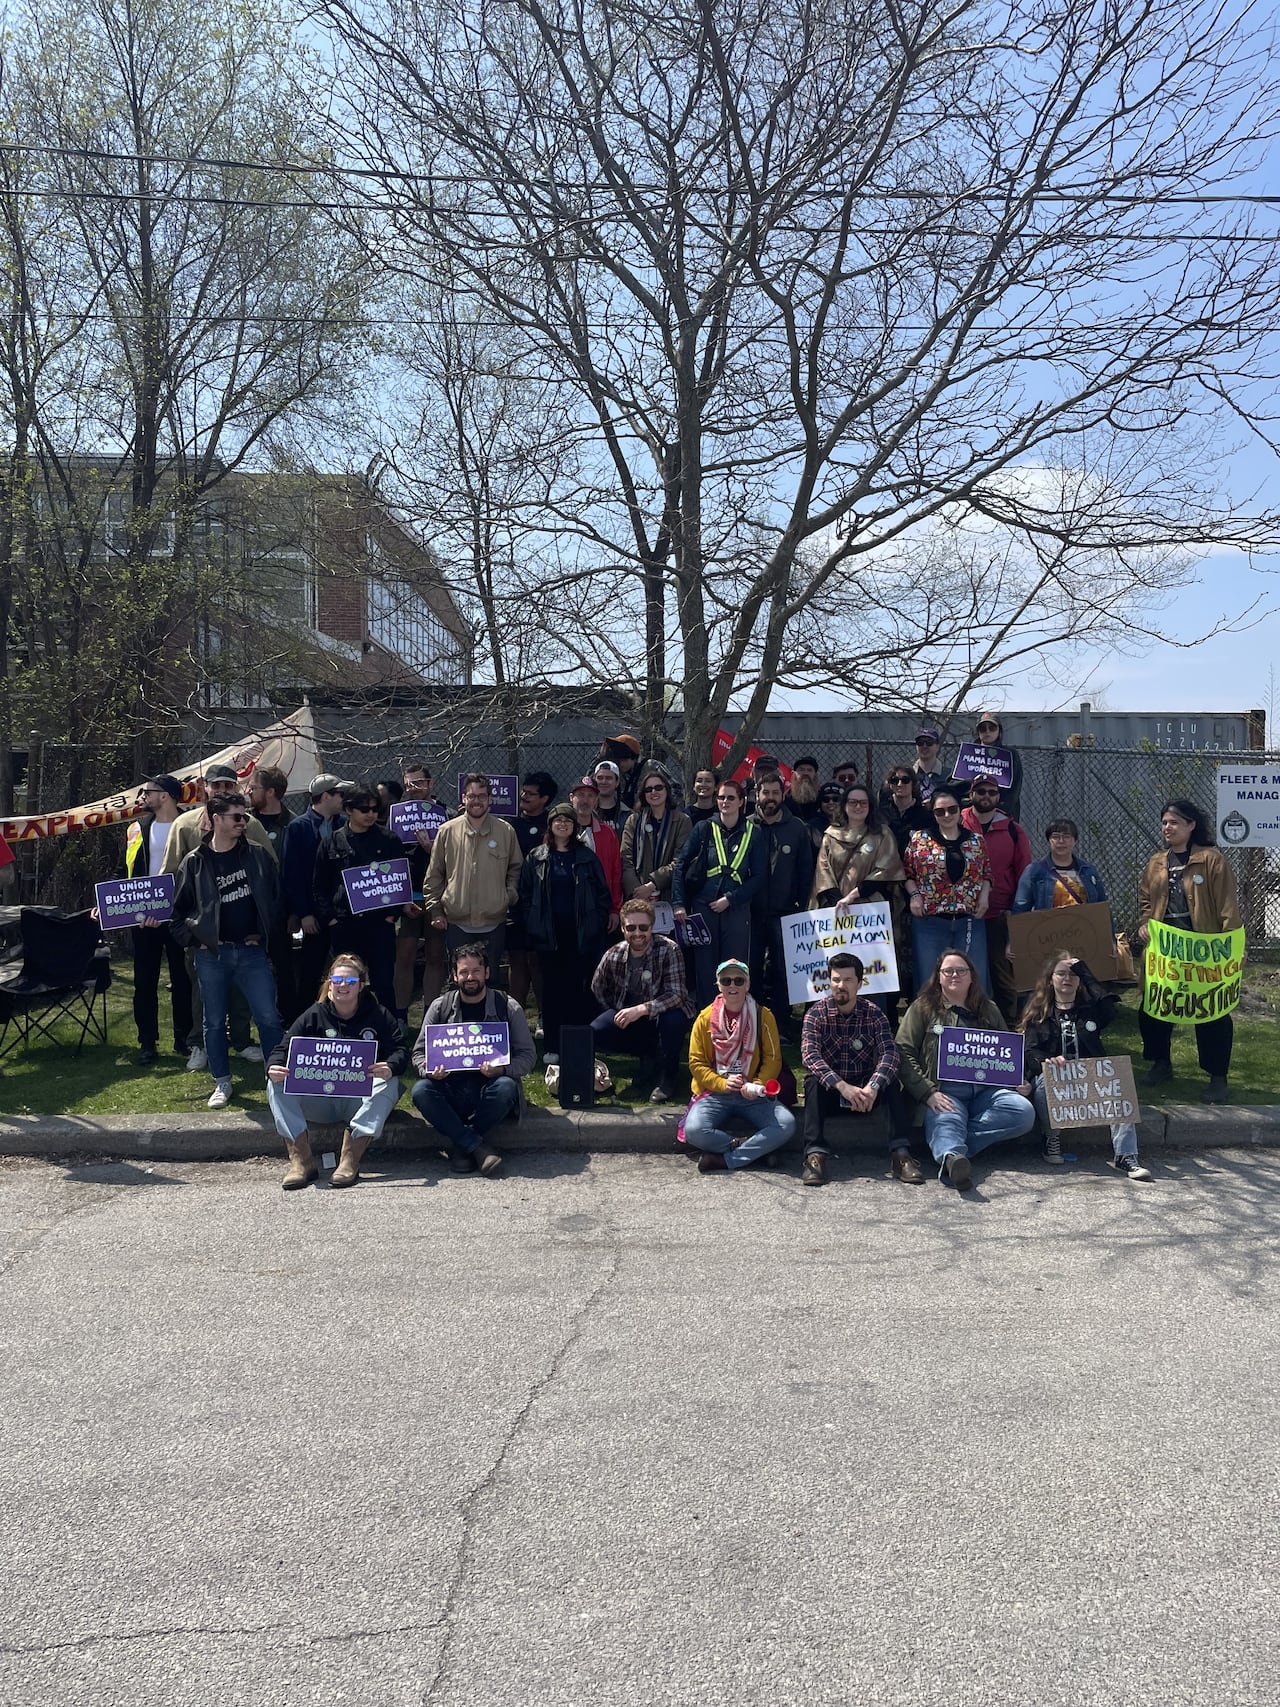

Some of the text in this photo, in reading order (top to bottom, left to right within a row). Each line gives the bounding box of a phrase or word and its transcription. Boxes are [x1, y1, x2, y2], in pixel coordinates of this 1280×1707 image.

[1156, 722, 1197, 734] TCLU
[974, 747, 986, 756] WE
[962, 754, 1010, 768] MAMA EARTH
[1220, 775, 1258, 784] FLEET
[1260, 775, 1268, 784] &
[1237, 791, 1279, 800] MANAG
[404, 803, 418, 812] WE
[395, 812, 446, 823] MAMA EARTH
[351, 871, 407, 890] MAMA EARTH
[835, 915, 856, 931] NOT
[854, 912, 886, 929] EVEN
[814, 934, 846, 951] REAL
[1159, 928, 1232, 963] UNION
[1148, 952, 1239, 983] BUSTING
[1148, 977, 1240, 1019] DISGUSTING
[446, 1026, 464, 1036] WE
[432, 1033, 503, 1048] MAMA EARTH
[1048, 1059, 1115, 1082] THIS IS
[1052, 1078, 1122, 1102] WHY WE
[1051, 1100, 1134, 1122] UNIONIZED
